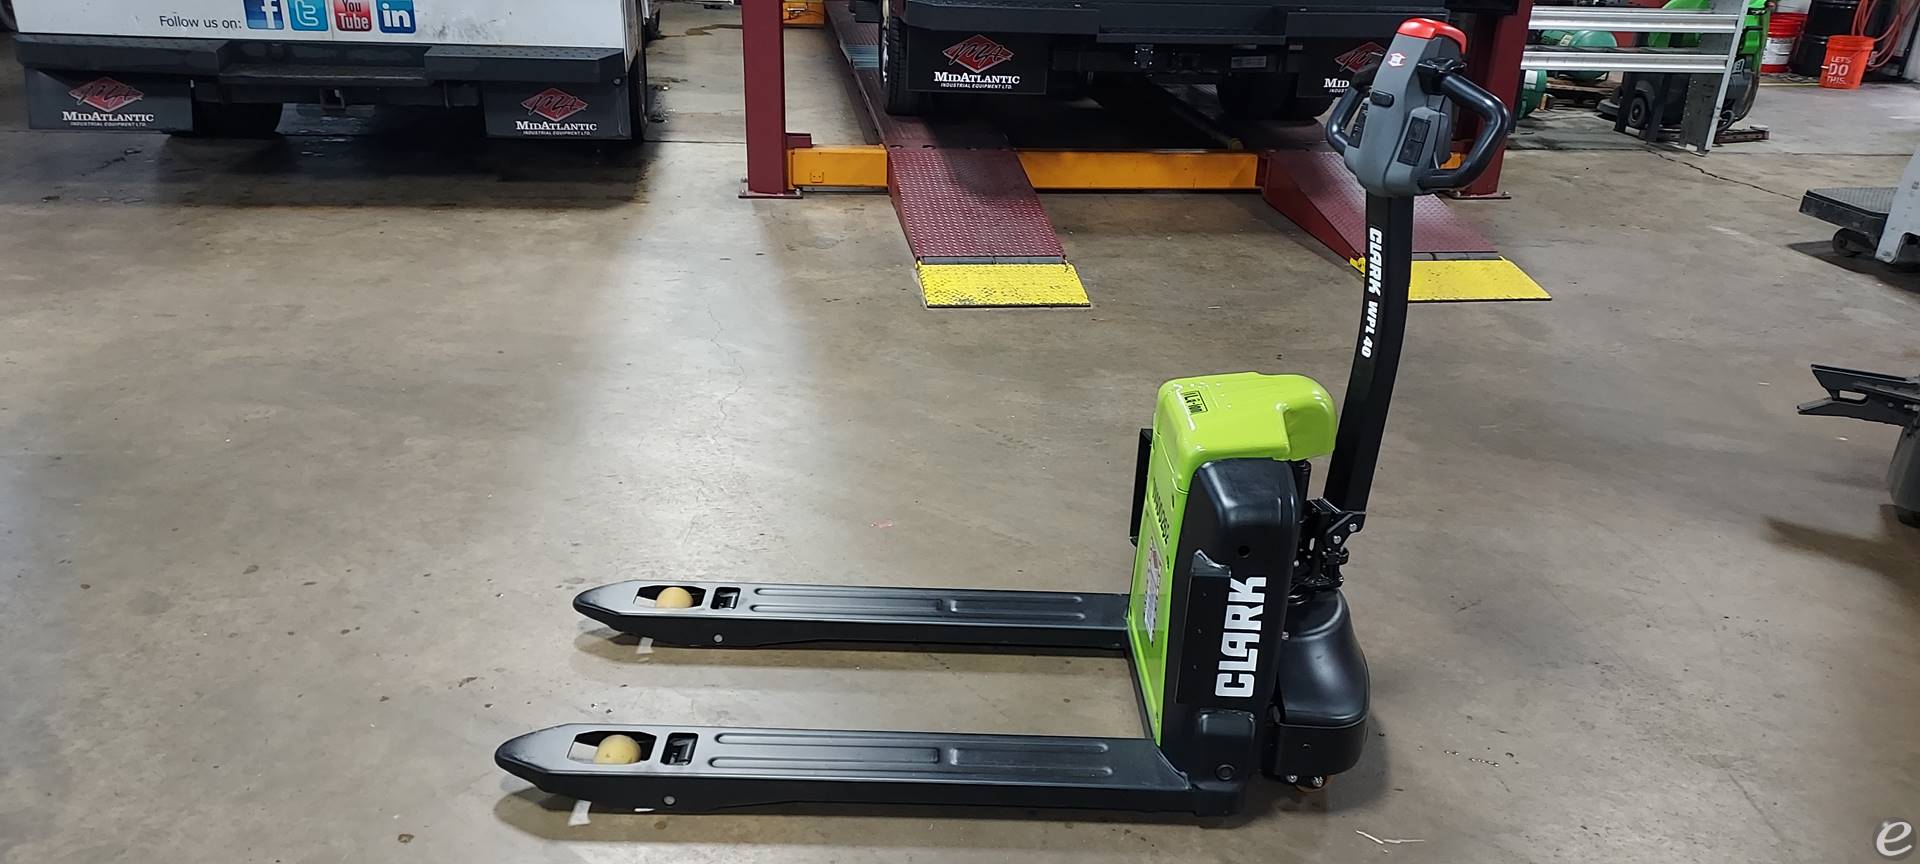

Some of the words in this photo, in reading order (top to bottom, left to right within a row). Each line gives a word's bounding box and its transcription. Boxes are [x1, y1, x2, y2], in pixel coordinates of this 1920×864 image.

[342, 0, 362, 12] You
[382, 3, 411, 28] in
[159, 16, 199, 27] Follow
[204, 19, 218, 28] us
[222, 20, 242, 29] on:
[338, 12, 369, 29] Tube
[1828, 63, 1849, 76] DO
[1368, 227, 1382, 297] CLARK
[1365, 301, 1378, 334] WPL
[1361, 336, 1374, 358] 40
[1215, 576, 1267, 697] CLARK
